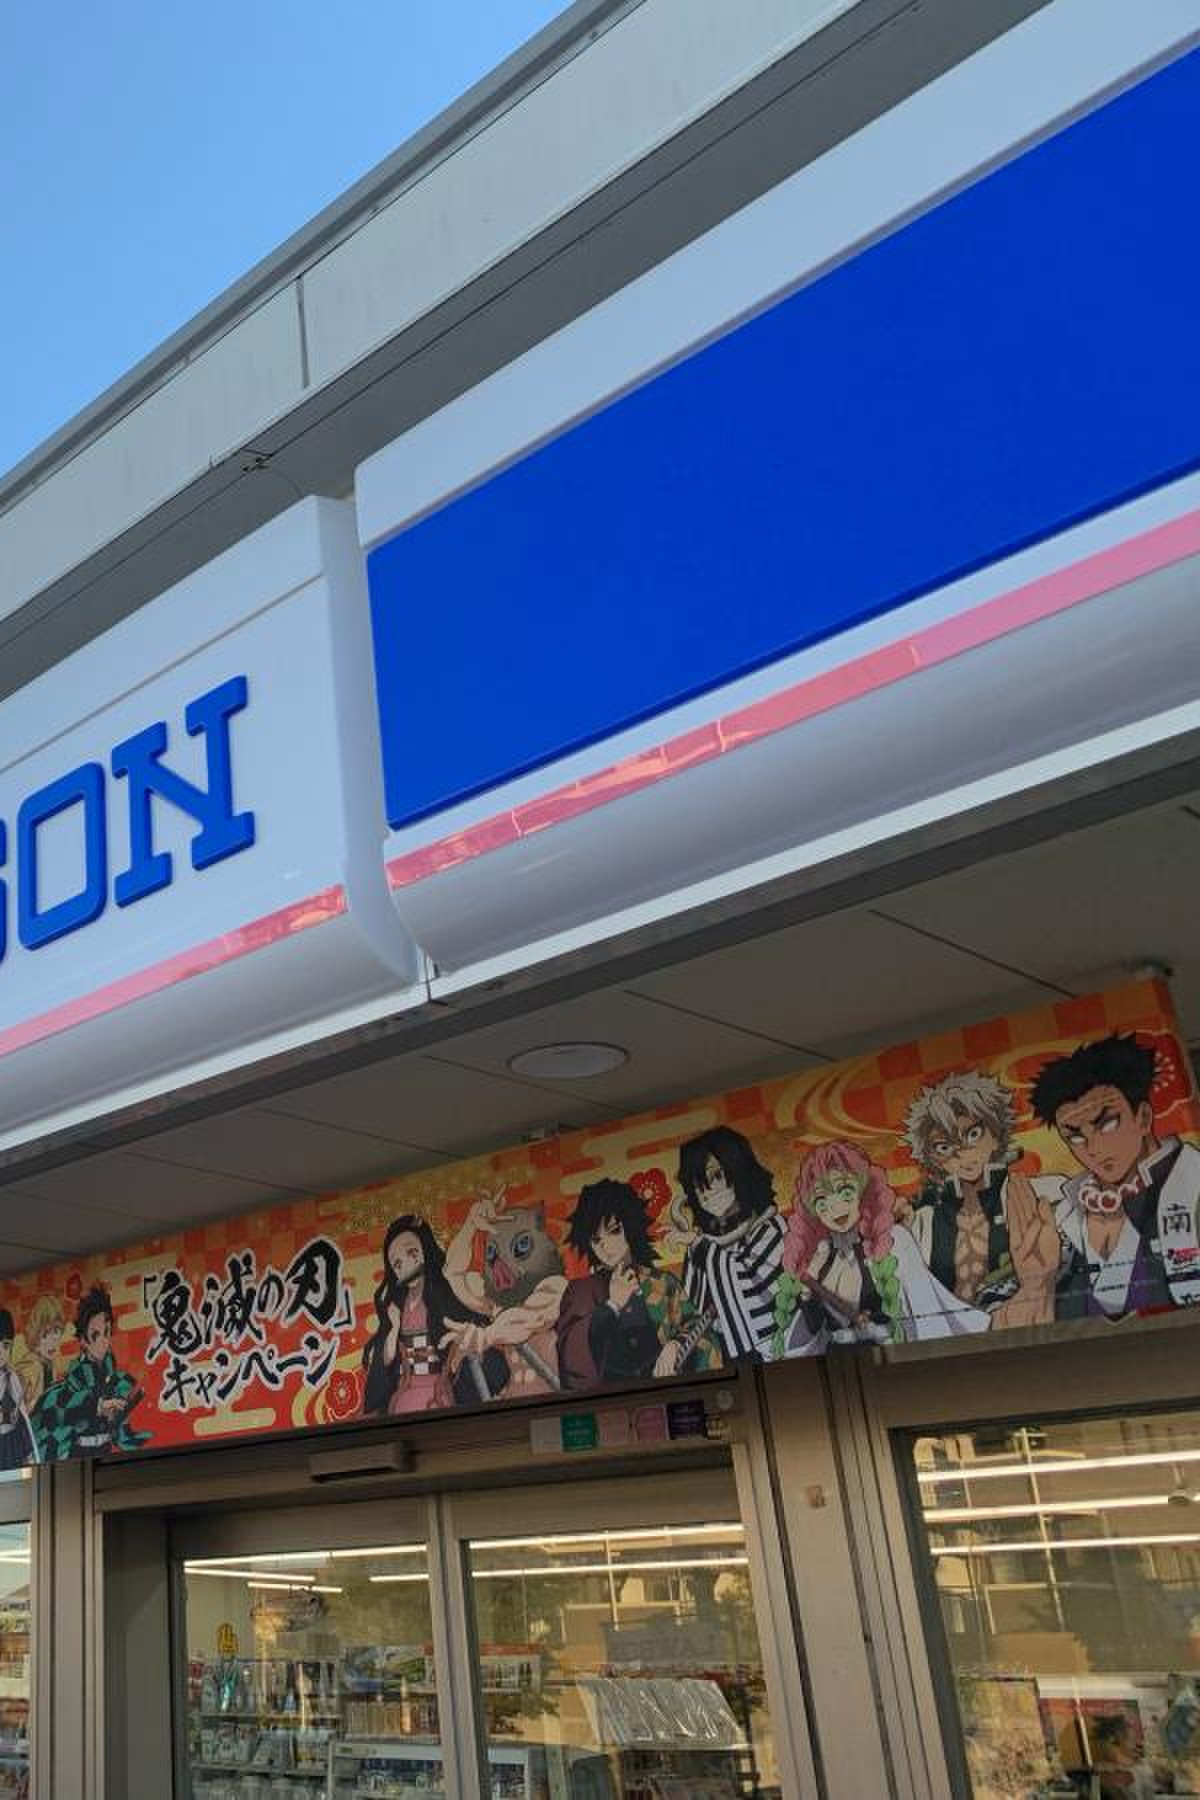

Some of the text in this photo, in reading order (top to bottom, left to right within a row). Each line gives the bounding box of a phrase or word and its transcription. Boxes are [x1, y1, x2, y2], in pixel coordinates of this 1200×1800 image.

[161, 1335, 337, 1408] キャンペーン
